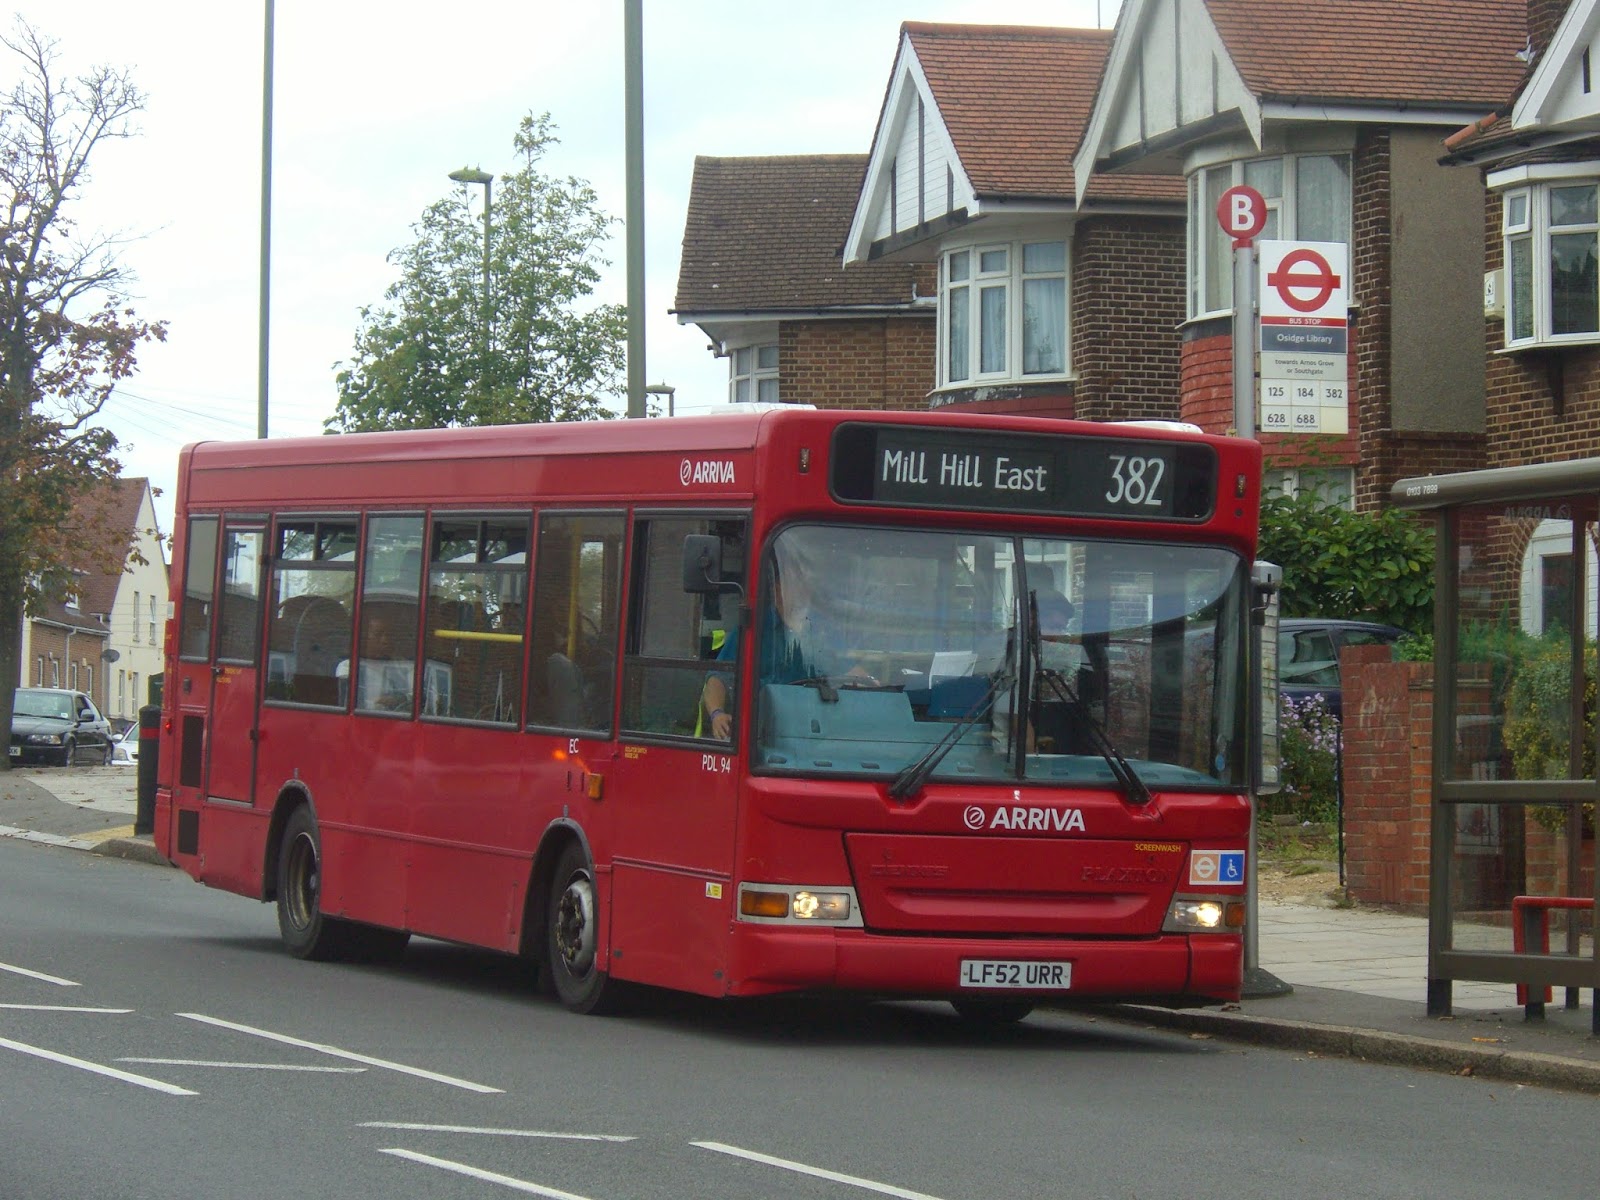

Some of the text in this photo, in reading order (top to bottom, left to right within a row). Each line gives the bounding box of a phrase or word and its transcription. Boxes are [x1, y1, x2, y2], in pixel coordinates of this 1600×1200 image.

[1231, 194, 1255, 231] B
[1277, 334, 1332, 344] Osidge Library
[1295, 368, 1323, 376] Southgate
[1268, 387, 1284, 397] 125
[1297, 388, 1314, 398] 184
[1326, 389, 1343, 398] 382
[1267, 413, 1286, 423] 628
[1296, 414, 1316, 424] 688
[692, 461, 735, 484] ARRIVA
[882, 449, 1047, 492] Mill Hill East
[1105, 455, 1166, 506] 382
[569, 738, 579, 754] EC
[702, 754, 731, 773] PDL 94
[990, 807, 1086, 832] ARRIVA
[1134, 843, 1181, 852] SCREENWASH
[969, 963, 1064, 985] LF52 URR
